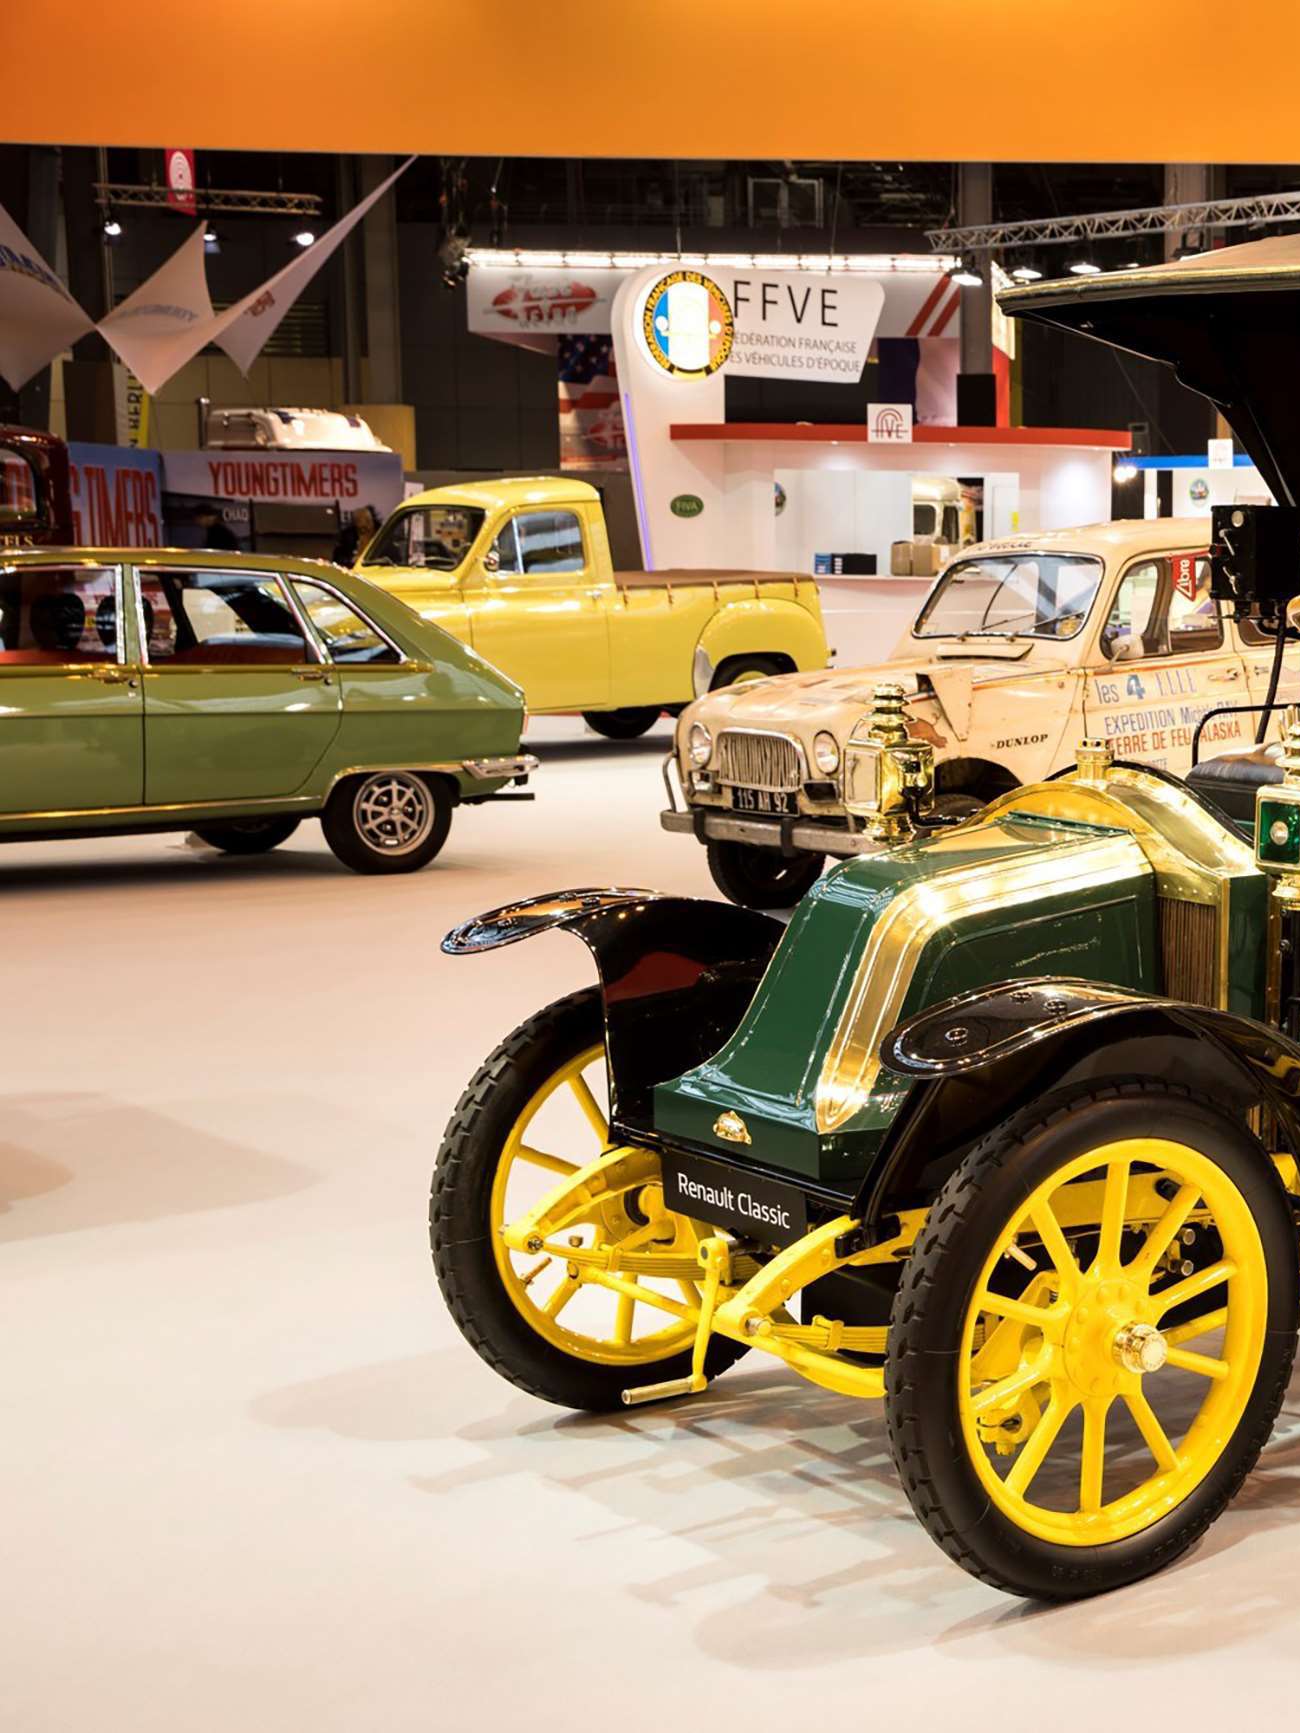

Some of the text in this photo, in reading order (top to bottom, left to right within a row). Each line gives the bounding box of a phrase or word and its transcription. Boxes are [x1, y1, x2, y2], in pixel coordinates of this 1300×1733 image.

[733, 280, 838, 327] FFVE
[735, 330, 857, 355] ÉDÉRATION FRANÇAISE
[743, 351, 804, 369] VÉHICULES
[208, 461, 359, 498] YOUNGTIMERS
[1094, 679, 1120, 705] les
[1126, 674, 1146, 700] 4
[1104, 708, 1176, 736] EXPEDITION
[1152, 731, 1168, 750] DE
[1171, 727, 1192, 747] FEU
[1199, 720, 1241, 743] ALASKA
[995, 734, 1049, 749] DUNLOP
[737, 789, 755, 809] 115
[677, 1172, 790, 1229] Renault Classic
